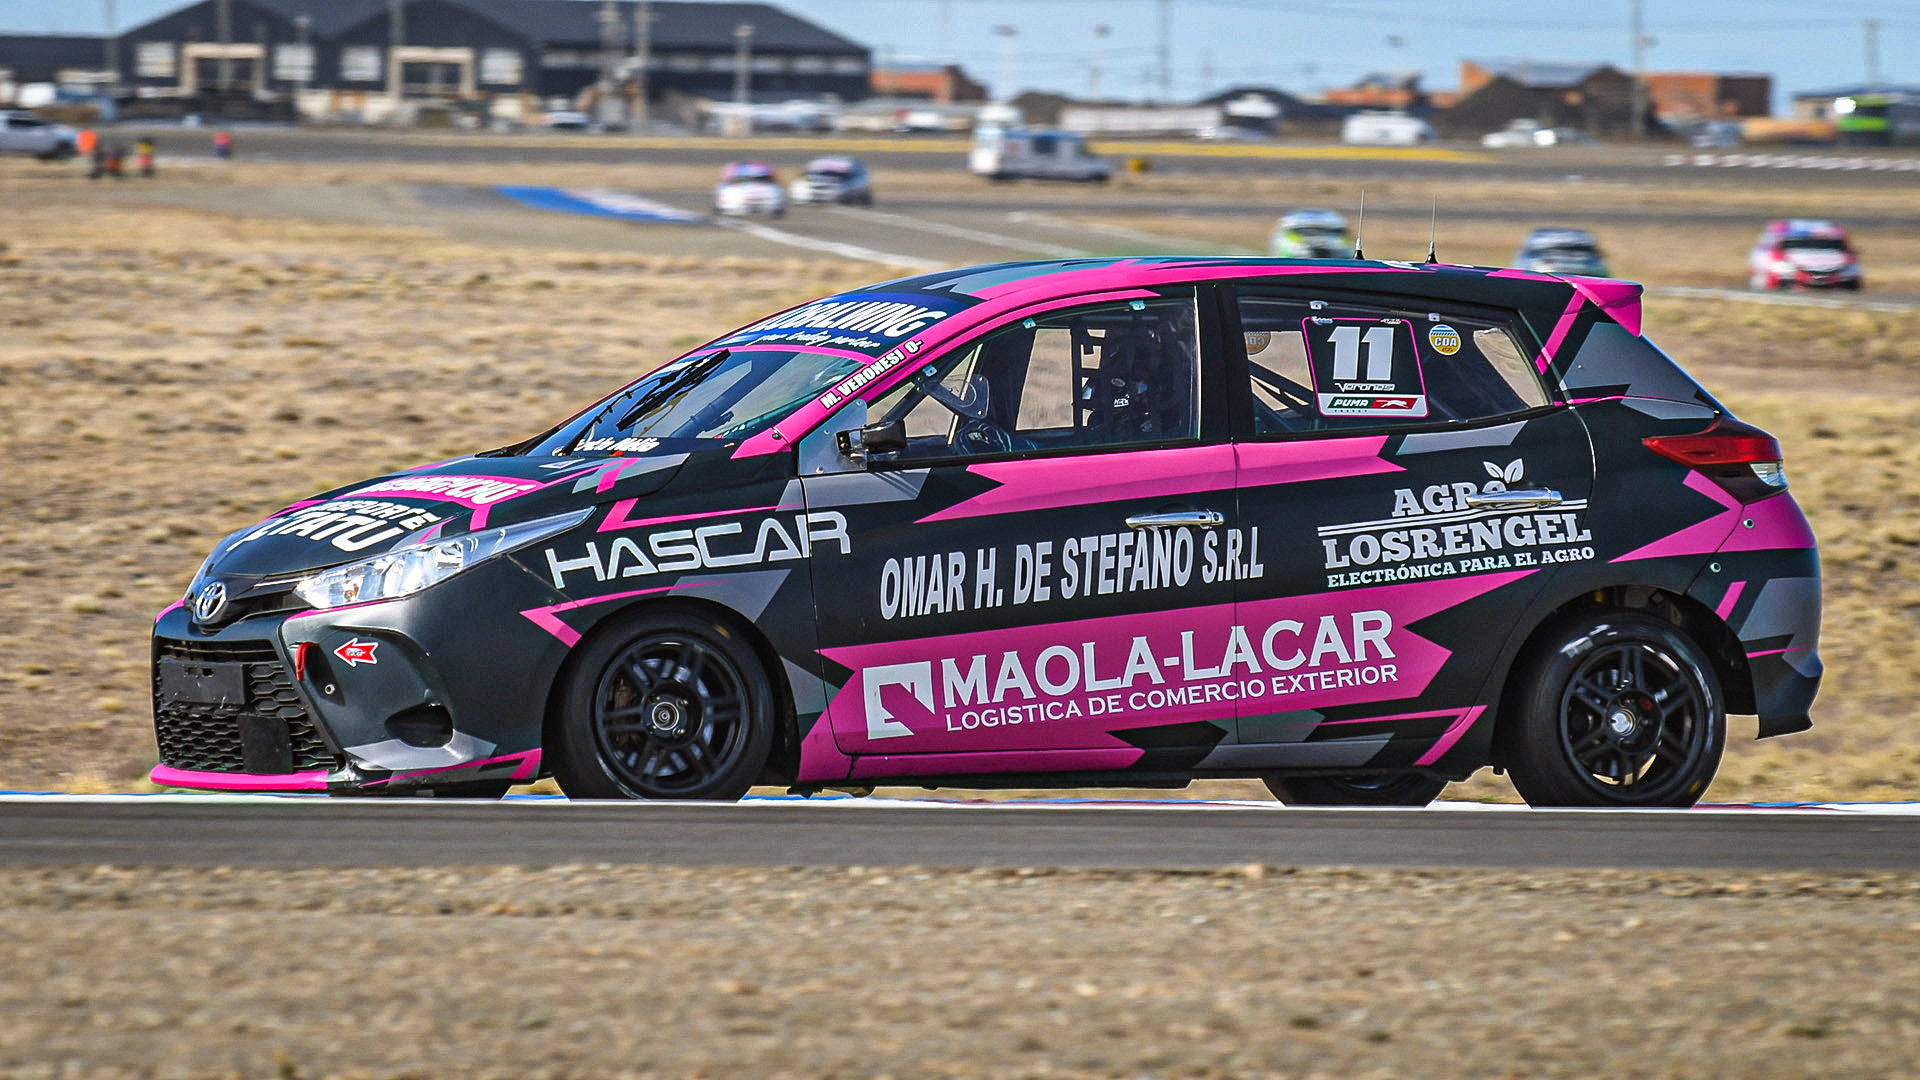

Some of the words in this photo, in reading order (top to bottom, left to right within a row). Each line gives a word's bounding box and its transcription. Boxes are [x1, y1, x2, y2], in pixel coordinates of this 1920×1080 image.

[1327, 326, 1395, 380] 11
[1434, 337, 1457, 347] CDA
[820, 392, 842, 409] M.
[836, 348, 905, 397] VERONESI
[1333, 399, 1369, 407] PUMA
[287, 500, 442, 531] SPORTE
[1322, 513, 1593, 570] LOSRENGEL
[544, 510, 851, 590] HASCAR
[879, 550, 966, 621] OMAR
[974, 546, 1003, 610] H.
[1013, 540, 1052, 605] DE
[1060, 527, 1195, 600] STEFANO
[1202, 526, 1265, 585] S.R.L
[1326, 561, 1457, 588] ELECTRÓNICA
[1460, 556, 1513, 574] PARA
[1514, 551, 1538, 567] EL
[1541, 546, 1596, 564] AGRO
[940, 609, 1396, 709] MAOLA-LACAR
[945, 700, 1084, 732] LOGISTICA
[1089, 692, 1125, 715] DE
[1128, 678, 1265, 711] COMERCIO
[1270, 663, 1399, 696] EXTERIOR
